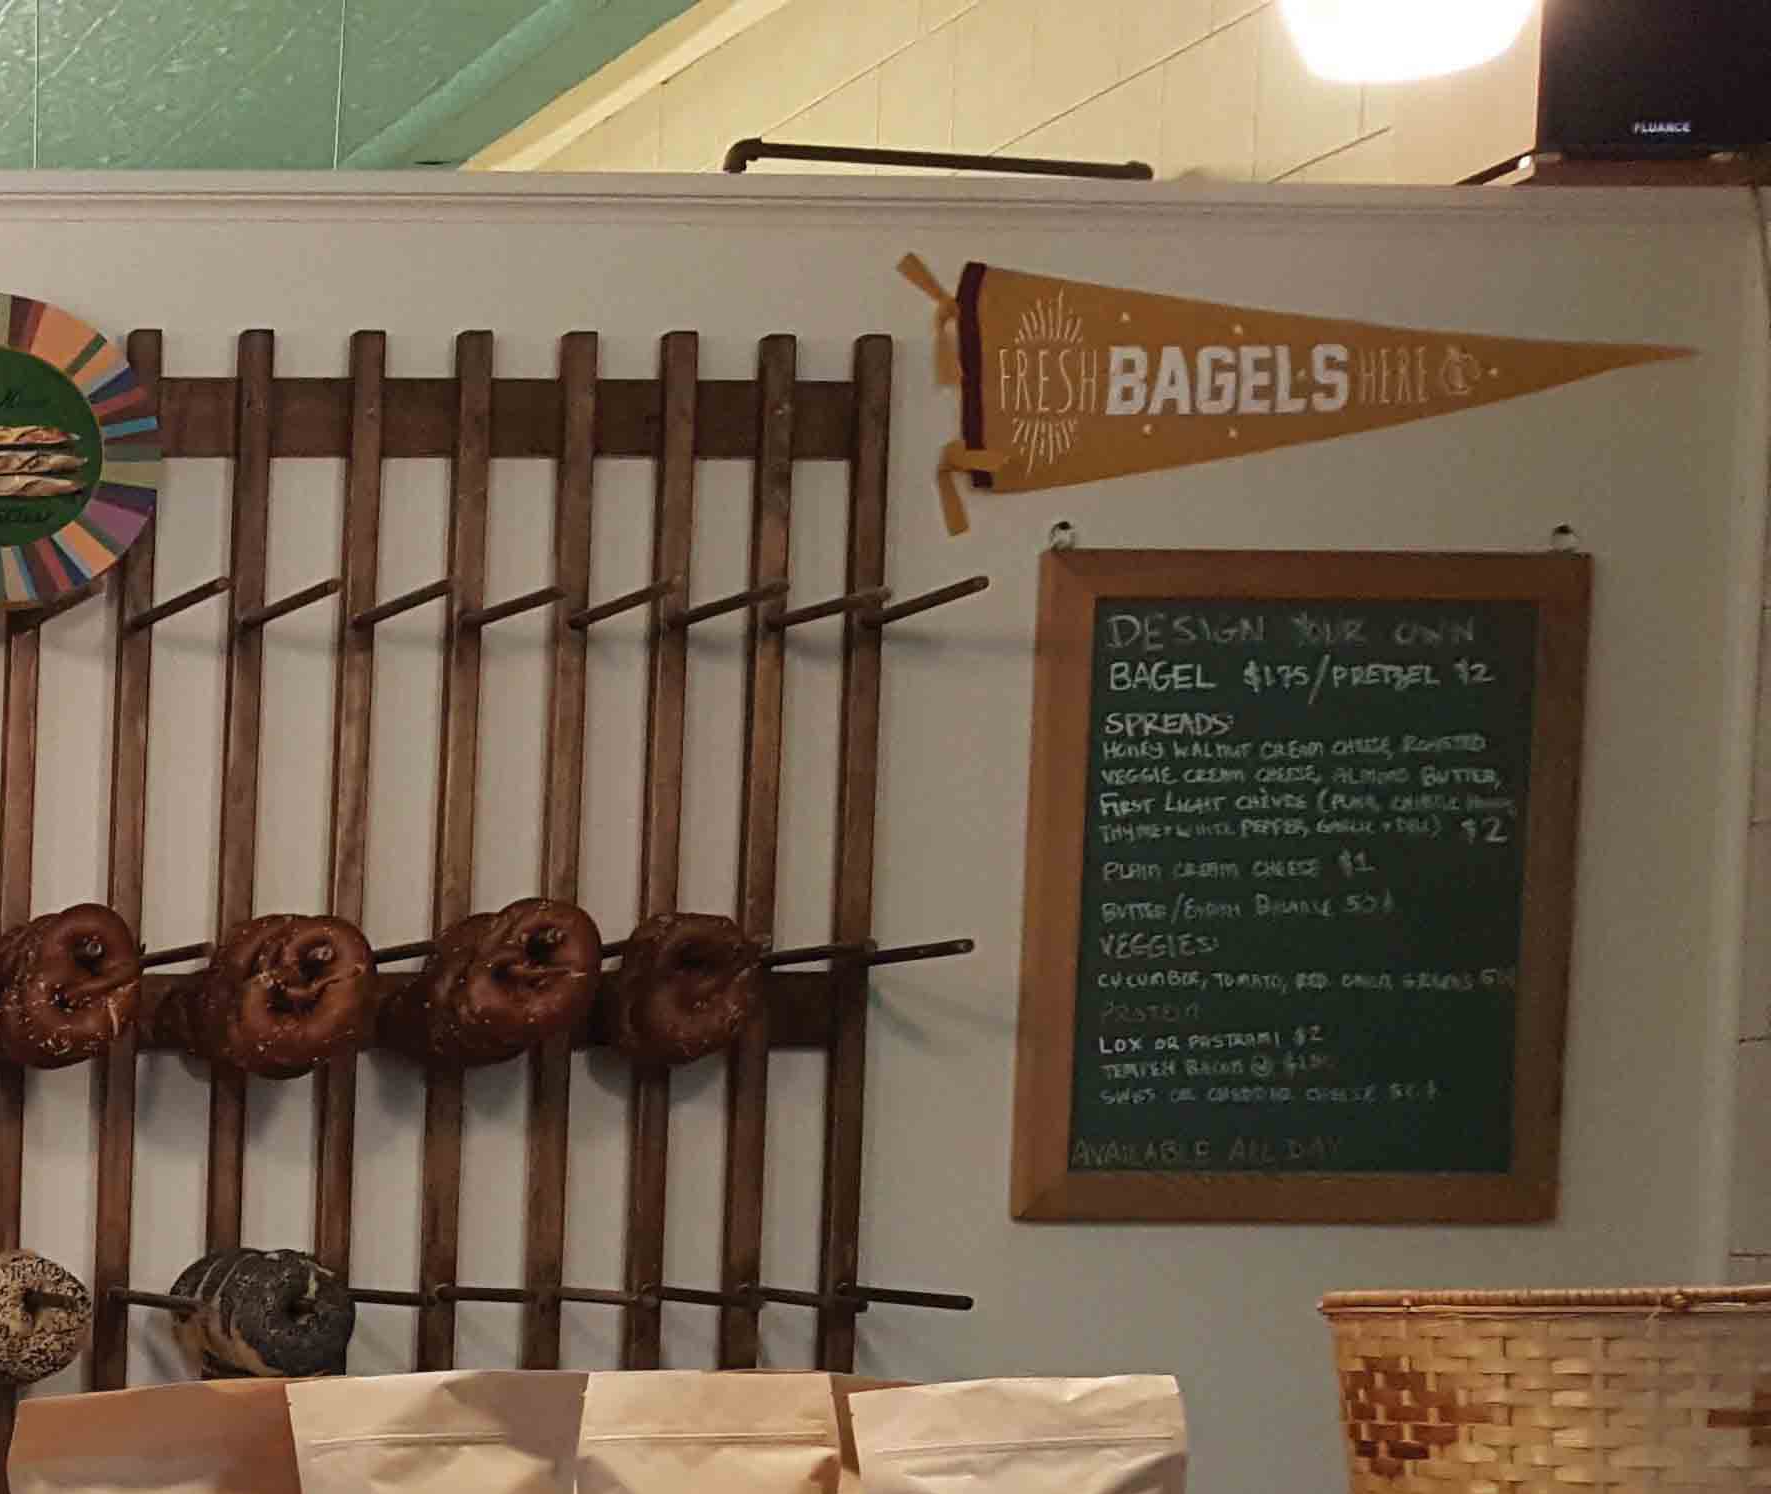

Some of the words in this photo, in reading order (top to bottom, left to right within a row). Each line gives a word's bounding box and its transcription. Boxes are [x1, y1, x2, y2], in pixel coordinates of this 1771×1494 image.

[997, 347, 1099, 414] FRESH
[1103, 342, 1352, 417] BAGELS
[1355, 345, 1430, 405] HERE
[1108, 660, 1217, 692] BAGEL
[1098, 1035, 1144, 1056] LOX
